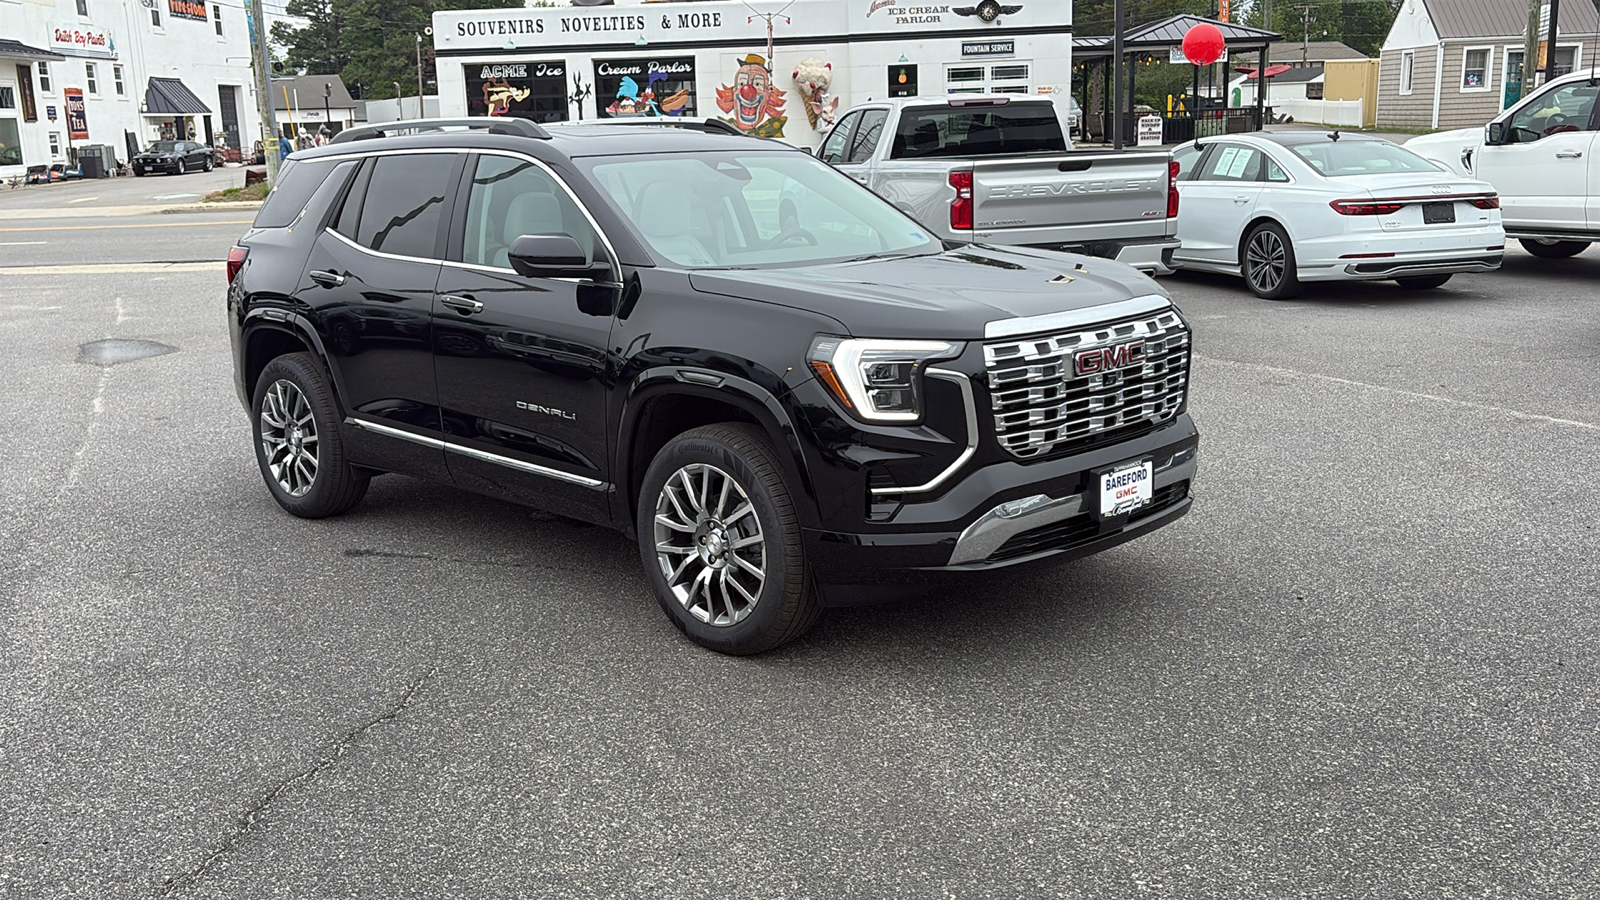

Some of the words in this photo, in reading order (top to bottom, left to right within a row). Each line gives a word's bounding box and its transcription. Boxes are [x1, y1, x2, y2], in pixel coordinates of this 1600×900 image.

[888, 7, 906, 16] ICE
[909, 5, 949, 15] CREAM
[457, 18, 545, 37] SOUVENIRS
[560, 15, 645, 33] NOVELTIES
[661, 15, 671, 30] &
[678, 12, 722, 29] MORE
[896, 15, 941, 24] PARLOR
[55, 28, 72, 42] Dutch
[74, 30, 86, 47] Boy
[87, 31, 105, 46] Paints
[963, 44, 990, 54] FOUNTAIN
[991, 43, 1012, 53] SERVICE
[480, 64, 527, 79] ACME
[536, 62, 564, 77] Ice
[597, 61, 641, 77] Cream
[647, 60, 693, 75] Parlor
[72, 116, 86, 130] TEA
[988, 179, 1158, 199] CHEVROLET
[1075, 340, 1147, 375] GMC
[516, 400, 576, 421] DENALI
[678, 442, 713, 455] Continental
[1105, 468, 1148, 492] BAREFORD
[1115, 486, 1138, 500] GMC
